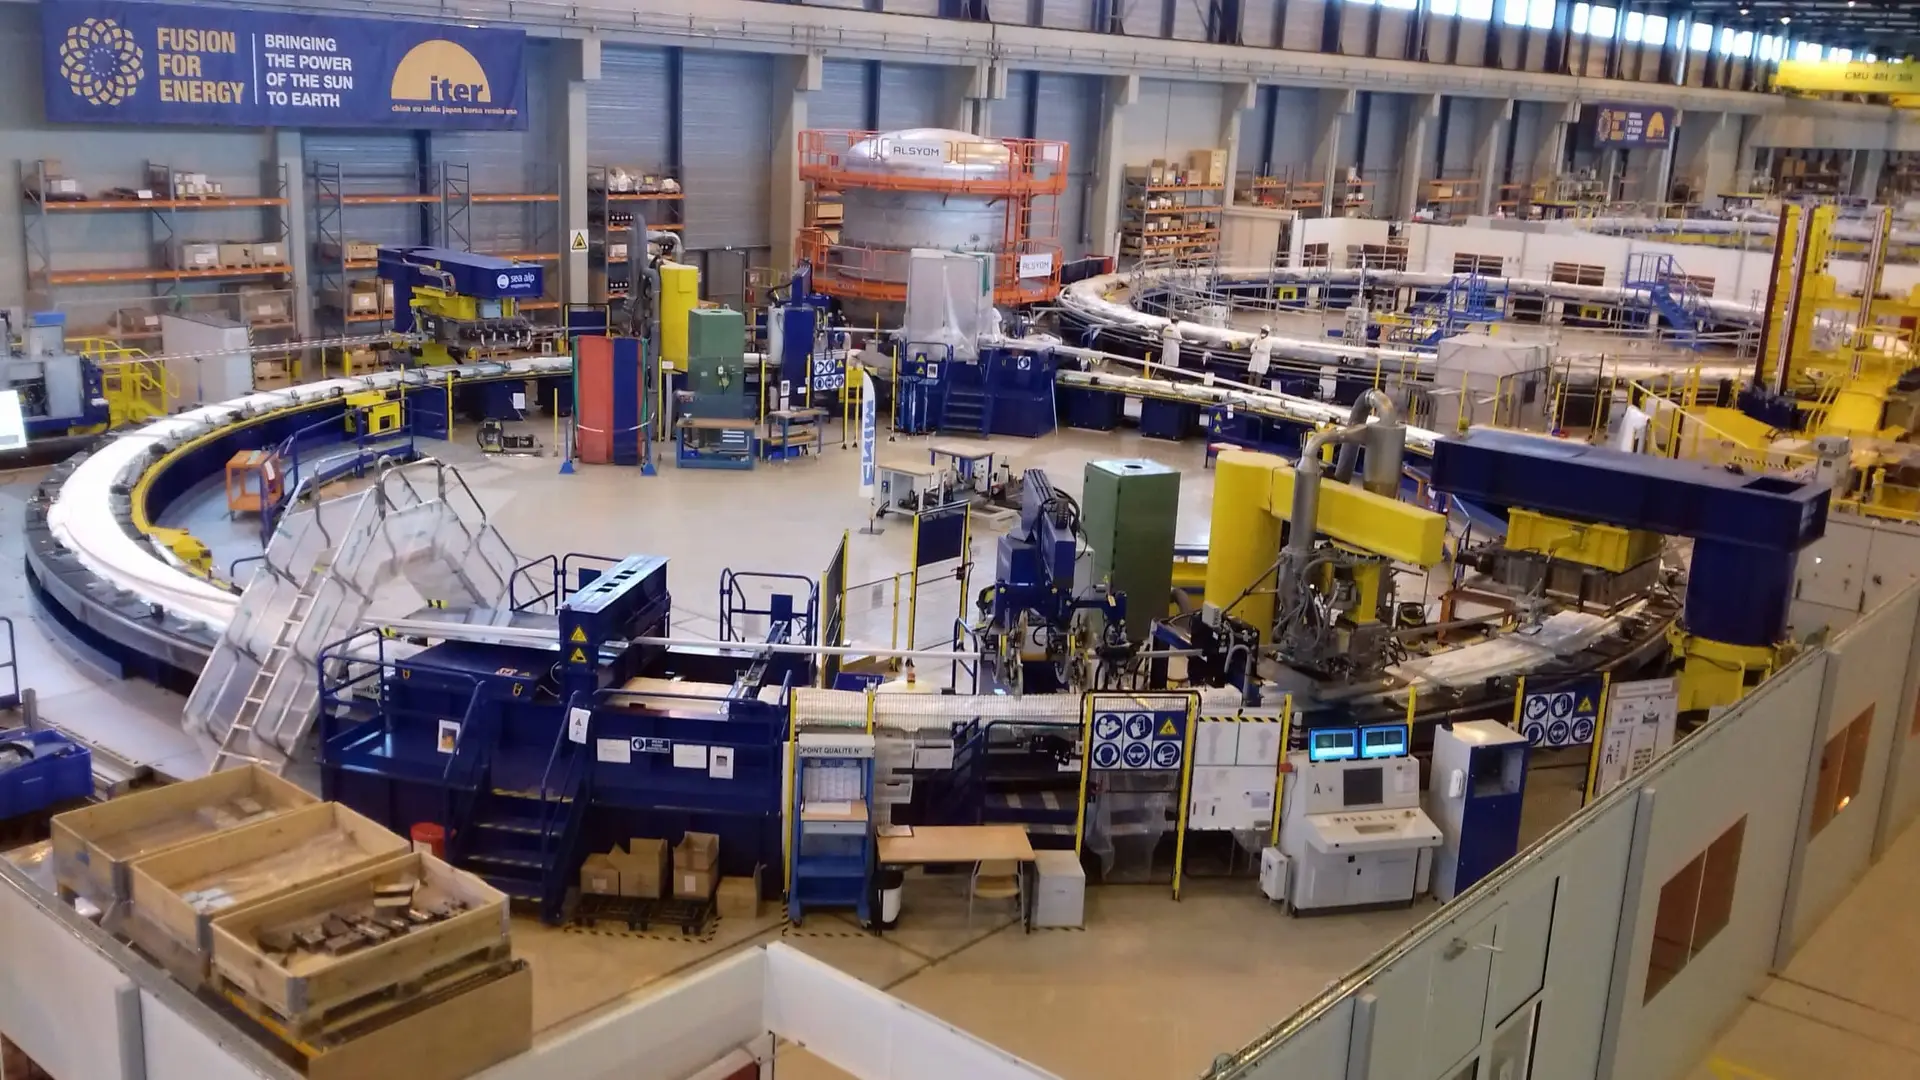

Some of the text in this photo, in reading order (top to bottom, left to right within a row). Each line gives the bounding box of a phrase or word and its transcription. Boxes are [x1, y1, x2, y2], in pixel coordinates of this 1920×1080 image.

[157, 27, 236, 54] FUSION
[264, 34, 337, 52] BRINGING
[158, 54, 202, 78] FOR
[265, 53, 352, 72] THE POWER
[266, 72, 353, 90] OF THE SUN
[1845, 72, 1869, 80] CMU
[159, 79, 245, 104] ENERGY
[430, 75, 483, 102] iter
[266, 91, 341, 108] TO EARTH
[893, 146, 939, 157] ALSYOM
[510, 271, 535, 283] sea alp
